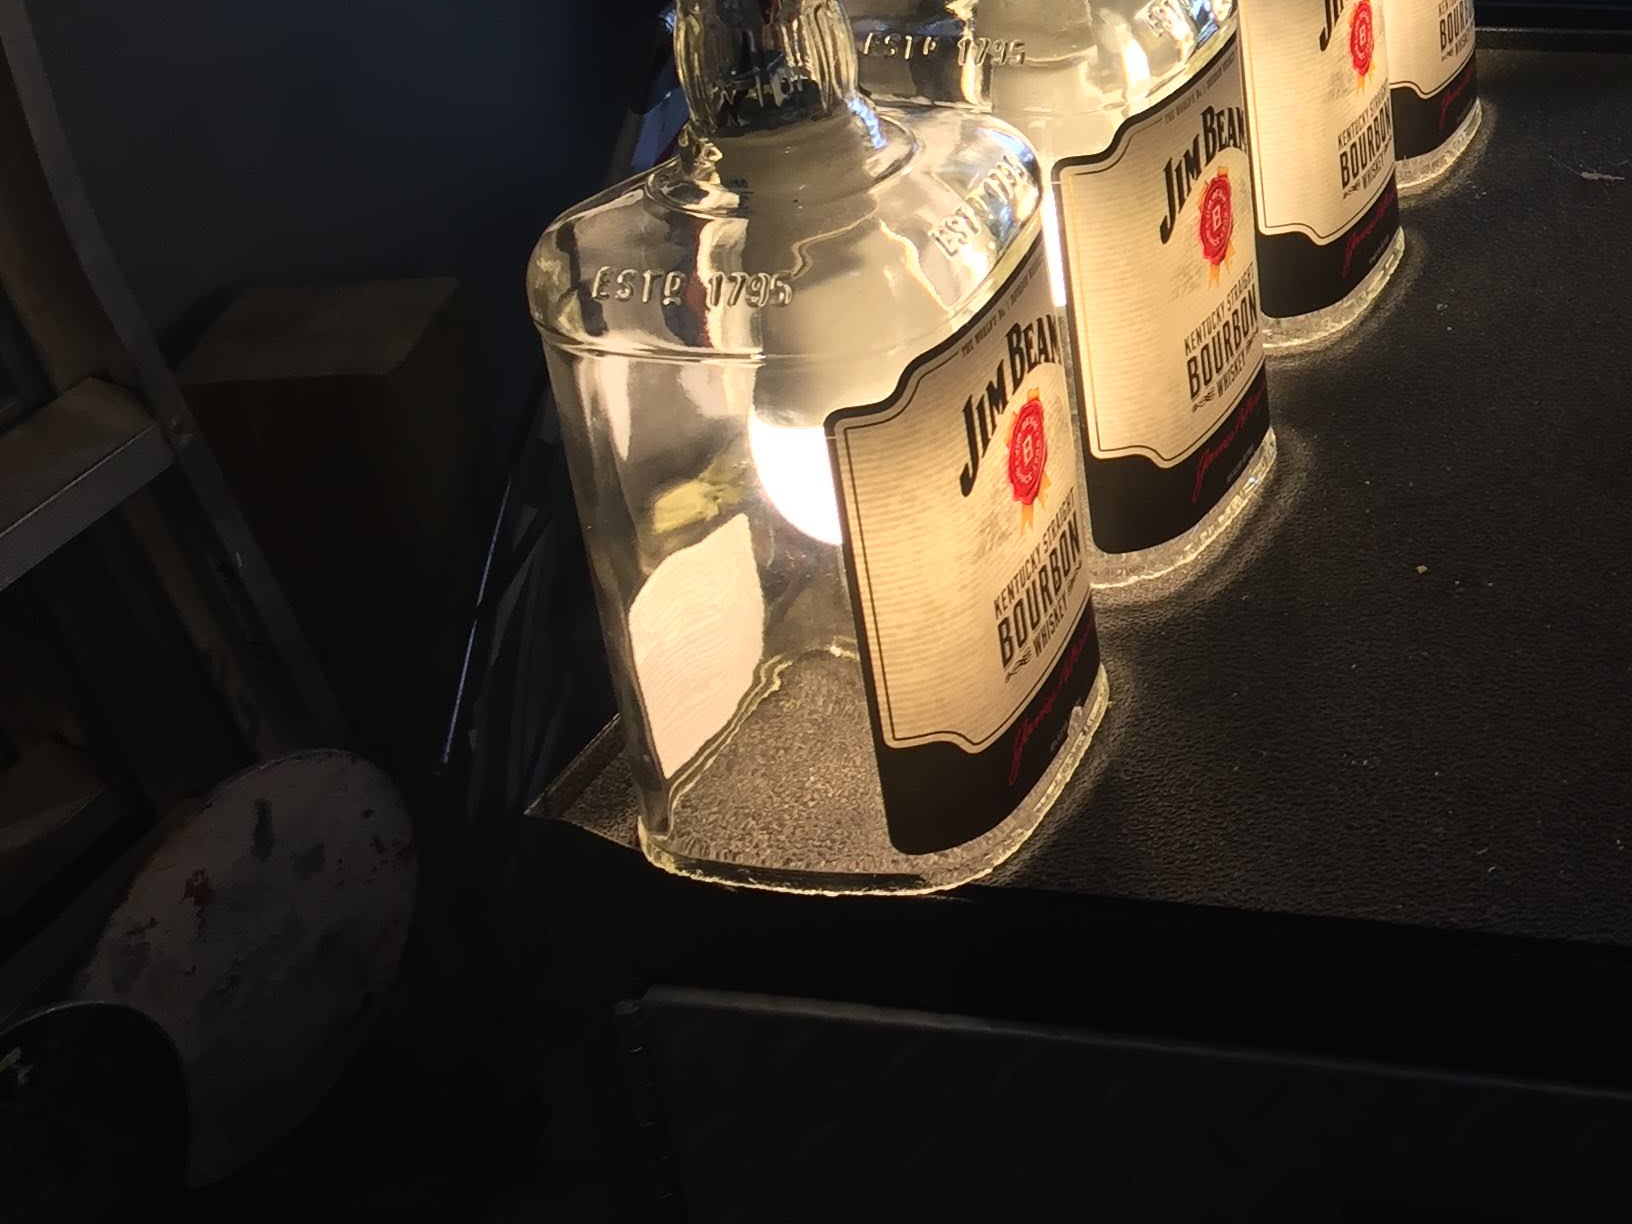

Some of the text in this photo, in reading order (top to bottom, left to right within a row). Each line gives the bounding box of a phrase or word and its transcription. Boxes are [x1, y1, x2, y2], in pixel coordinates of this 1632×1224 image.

[957, 36, 1026, 67] 1795
[1159, 132, 1203, 245] JIM
[1339, 97, 1392, 190] BOURBON
[707, 270, 793, 308] 1795
[1183, 261, 1255, 357] KENTUCKY STRAIGHT
[1186, 282, 1260, 401] BOURBON
[1214, 352, 1246, 400] WHISKEY
[960, 313, 1062, 498] JIM BEAM
[994, 486, 1076, 621] KENTUCKY STRAIGHT
[996, 510, 1082, 669] BOURBON
[1032, 594, 1069, 658] WHISKEY
